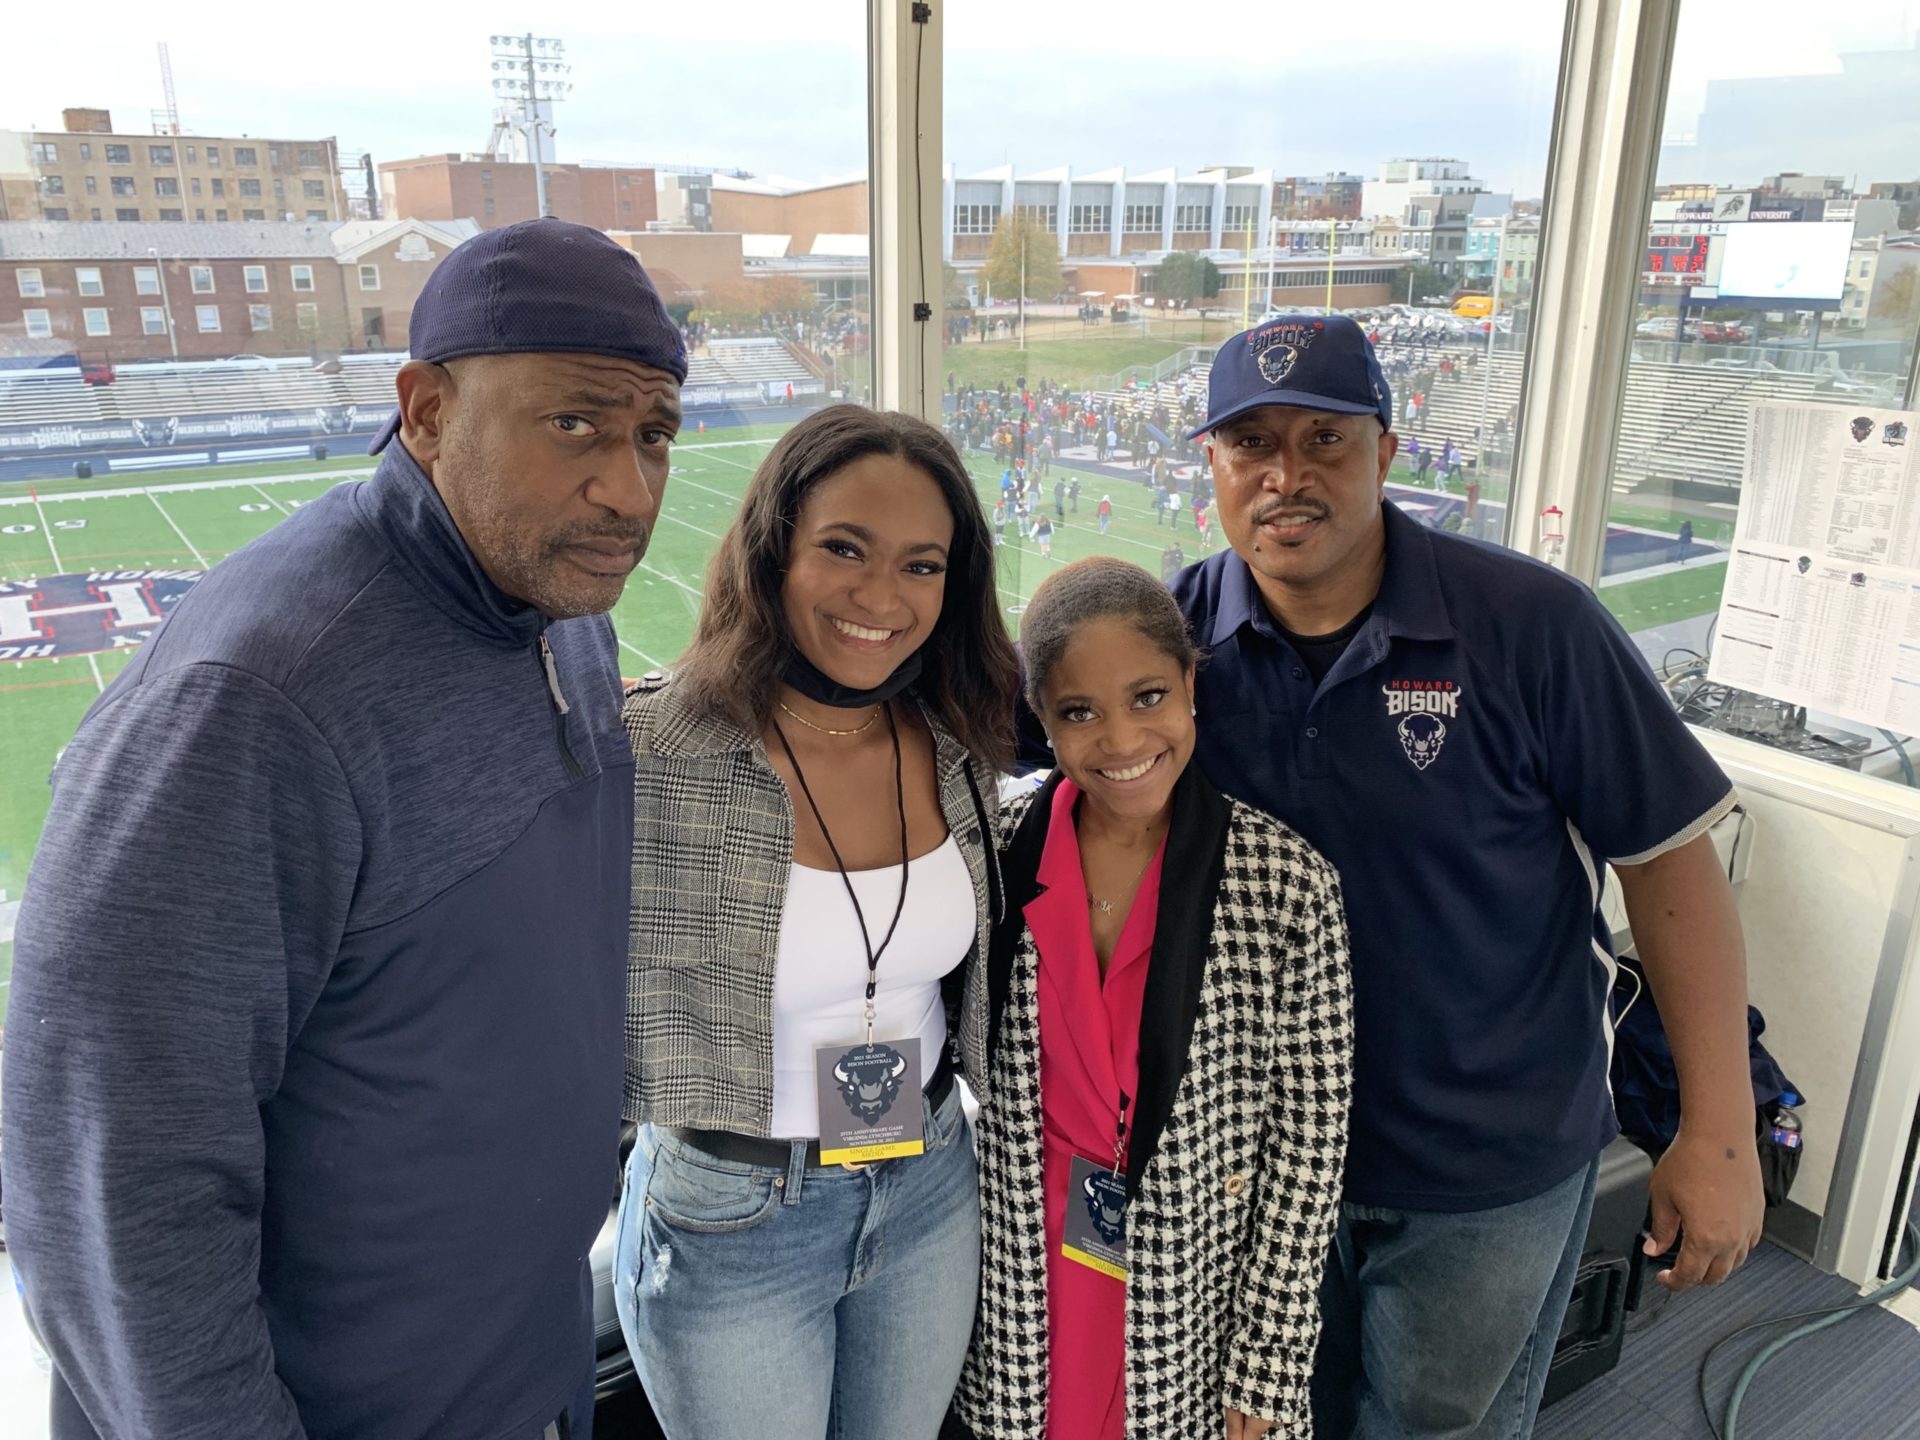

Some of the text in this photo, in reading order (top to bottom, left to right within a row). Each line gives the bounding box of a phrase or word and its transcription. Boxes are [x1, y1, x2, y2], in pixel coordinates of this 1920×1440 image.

[1750, 210, 1792, 220] UNIVERSITY
[1248, 329, 1316, 357] BISON
[225, 417, 270, 436] BISON
[31, 428, 82, 449] BISON
[1392, 680, 1453, 690] HOWARD
[1382, 684, 1462, 718] BISON
[865, 1052, 887, 1060] SEASON
[865, 1058, 893, 1066] FOOTBALL
[854, 1127, 888, 1135] ANNIVERSARY
[842, 1134, 868, 1142] VIRGINIA
